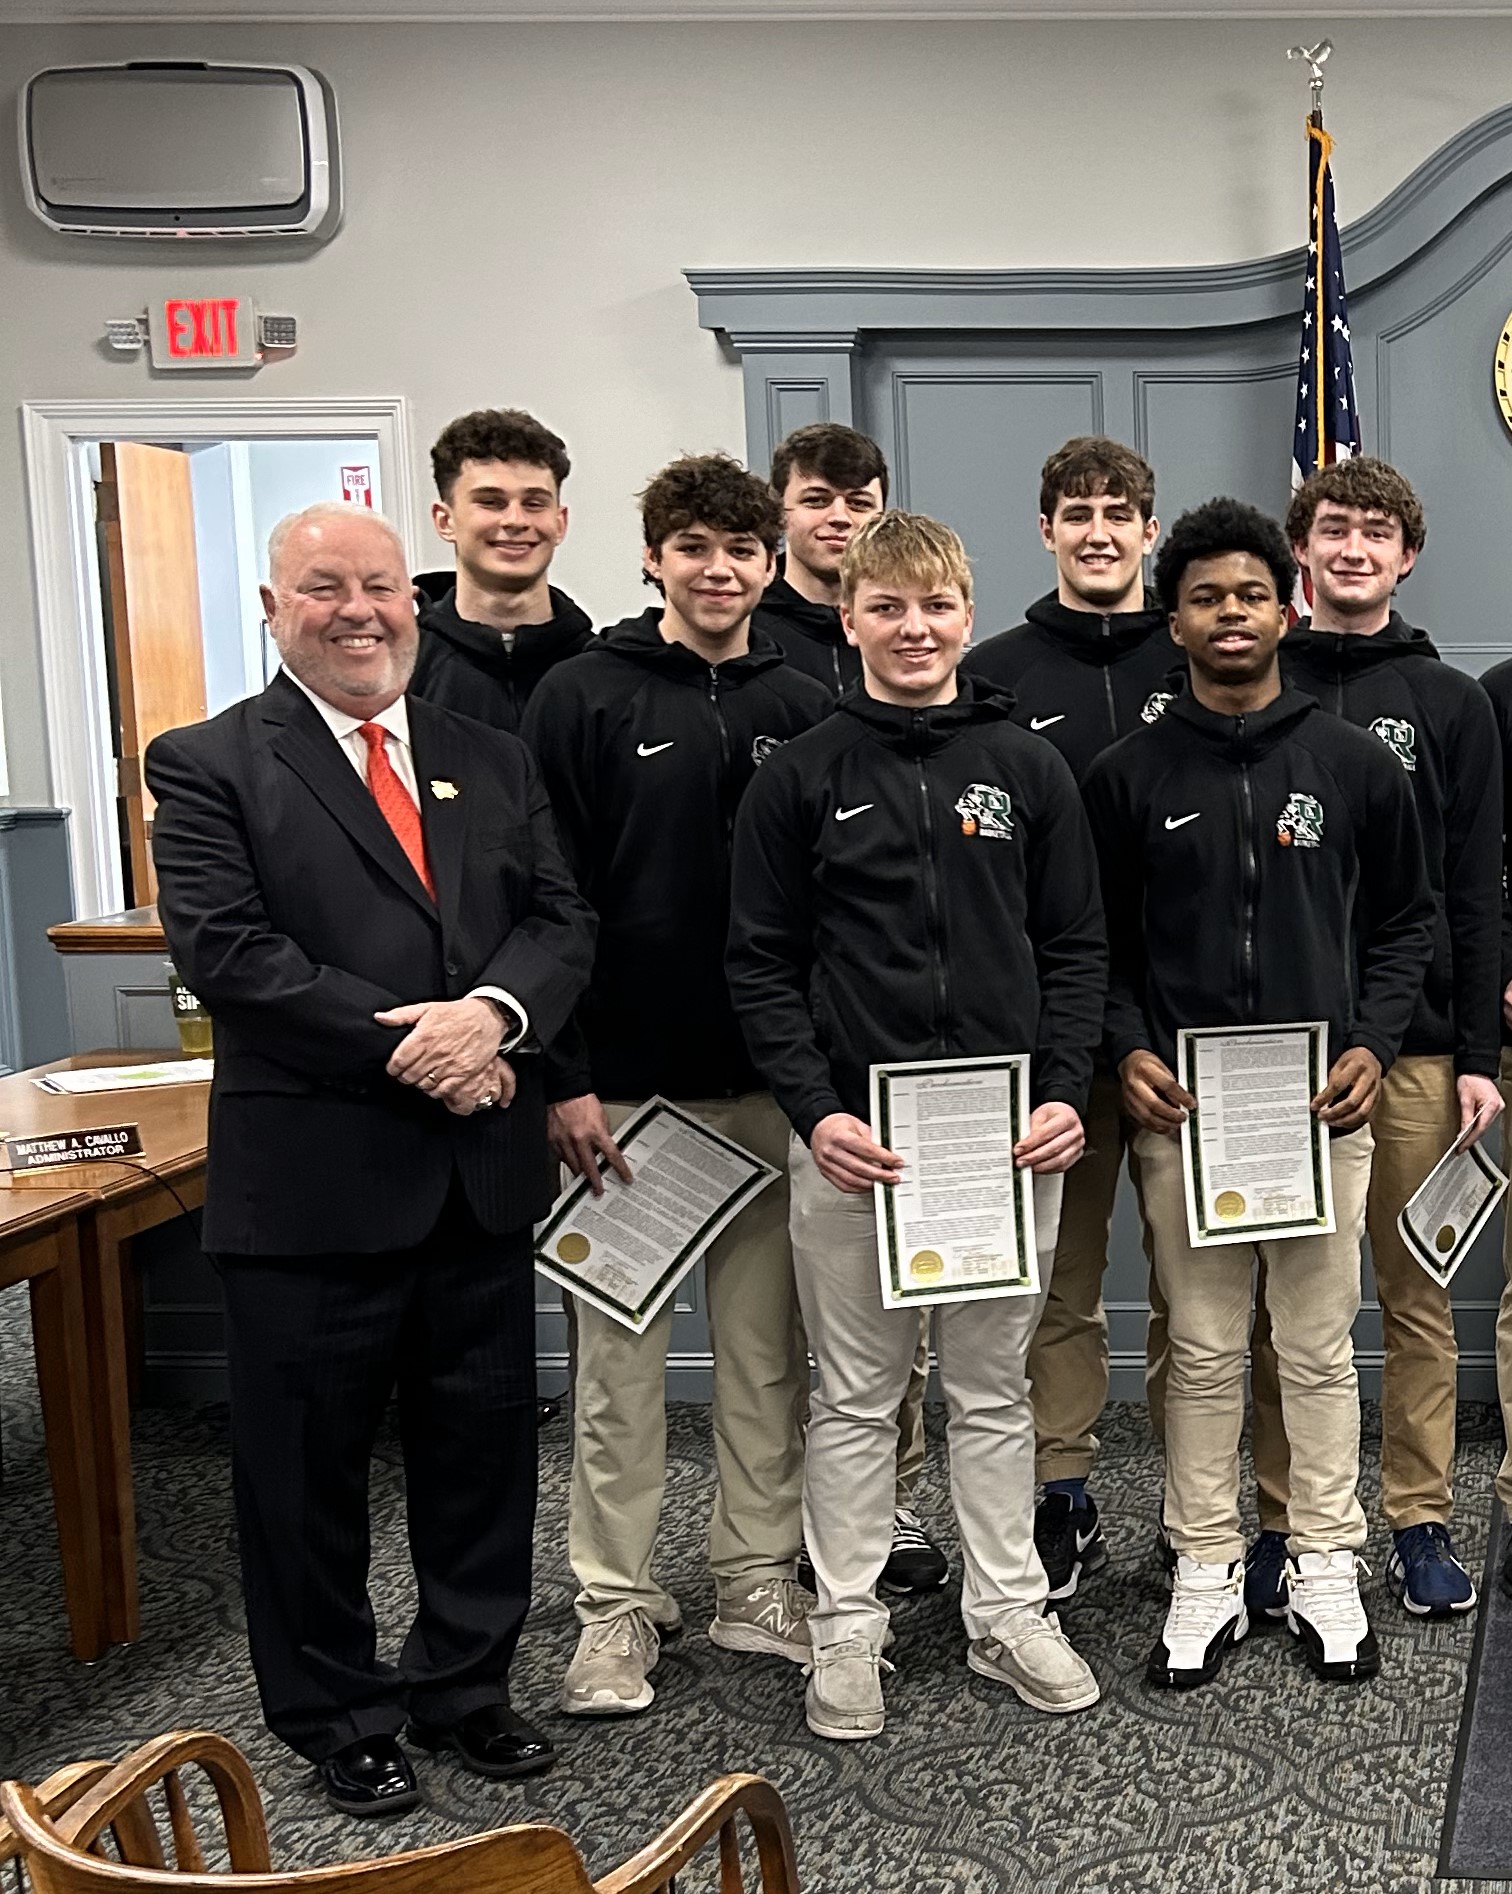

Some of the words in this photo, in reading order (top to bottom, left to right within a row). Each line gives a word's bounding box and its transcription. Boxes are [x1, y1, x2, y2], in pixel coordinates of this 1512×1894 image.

[165, 299, 240, 357] EXIT
[346, 474, 366, 486] FIRE
[16, 1139, 66, 1156] MATTHEW
[71, 1138, 82, 1149] A.
[84, 1131, 129, 1147] CAVALLO
[27, 1144, 125, 1165] ADMINISTRATOR
